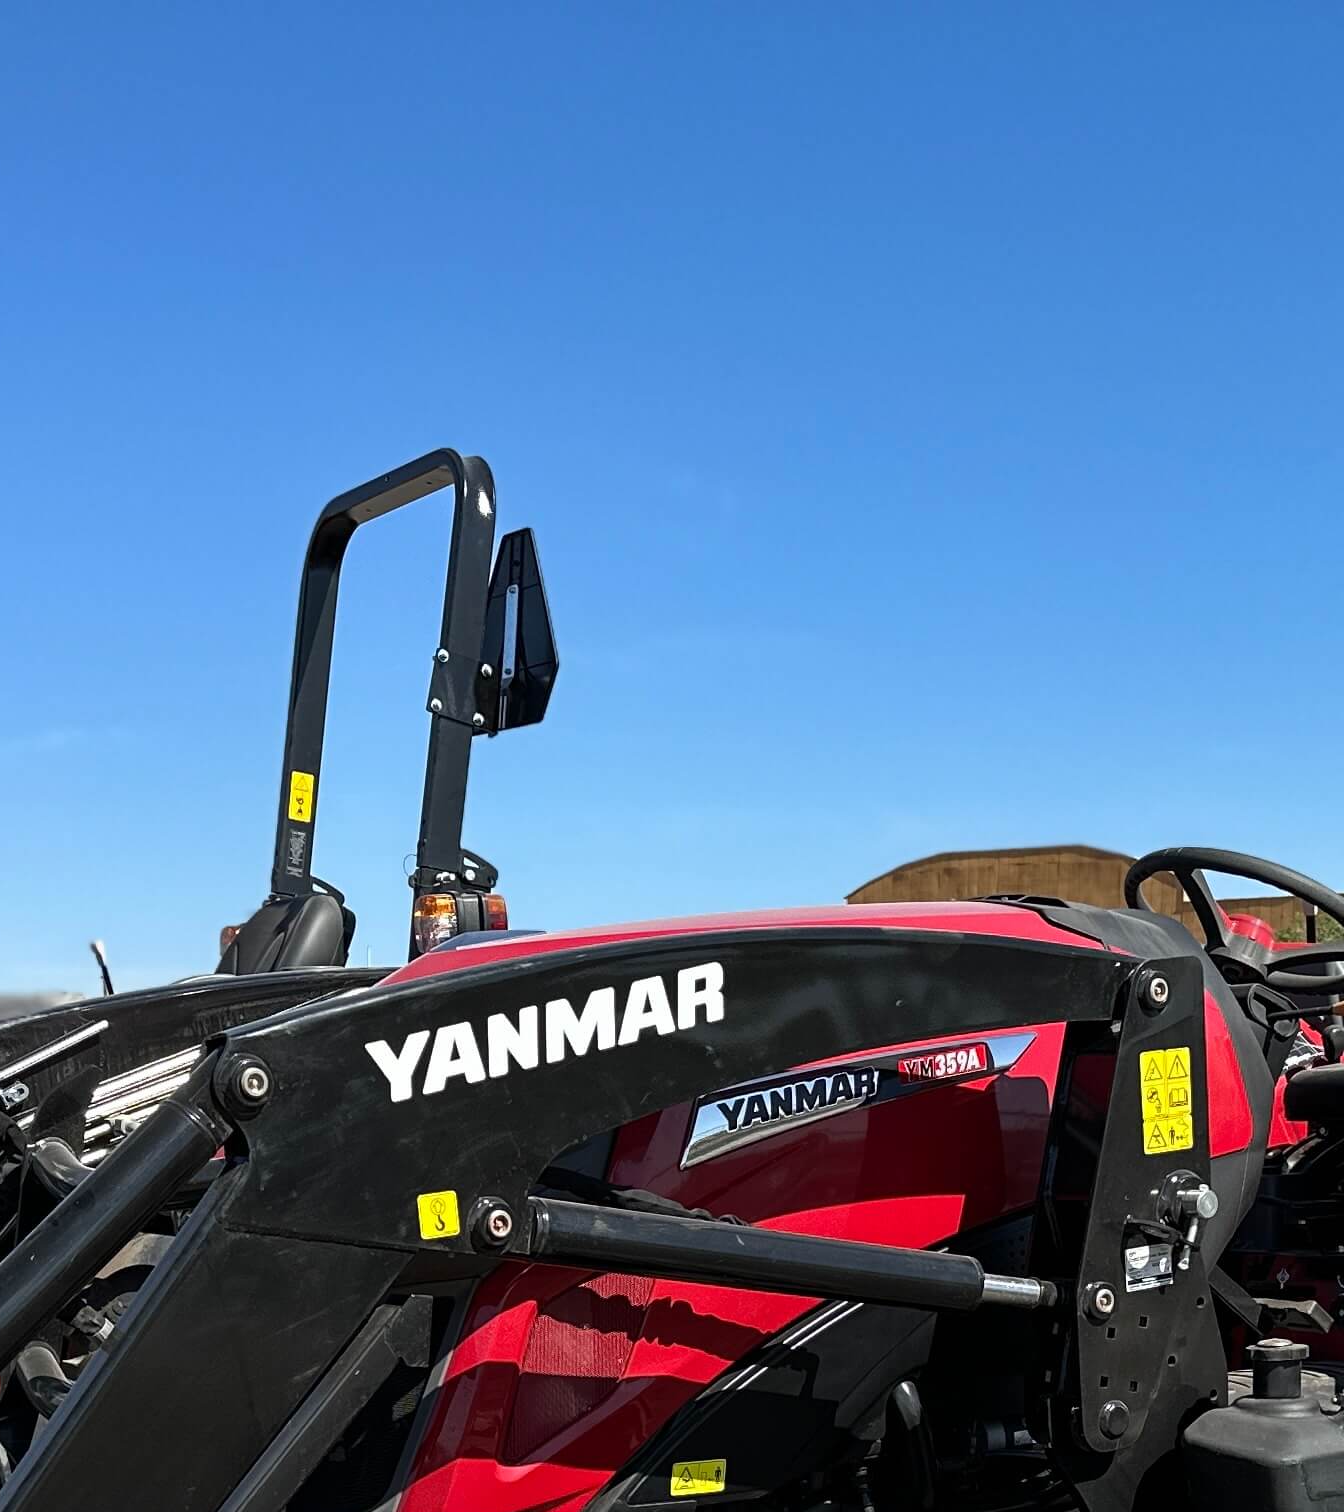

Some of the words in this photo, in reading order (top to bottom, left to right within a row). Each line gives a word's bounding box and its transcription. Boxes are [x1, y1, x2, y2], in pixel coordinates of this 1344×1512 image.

[364, 961, 725, 1103] YANMAR
[717, 1067, 880, 1133] YANMAR
[905, 1047, 981, 1083] YM359A
